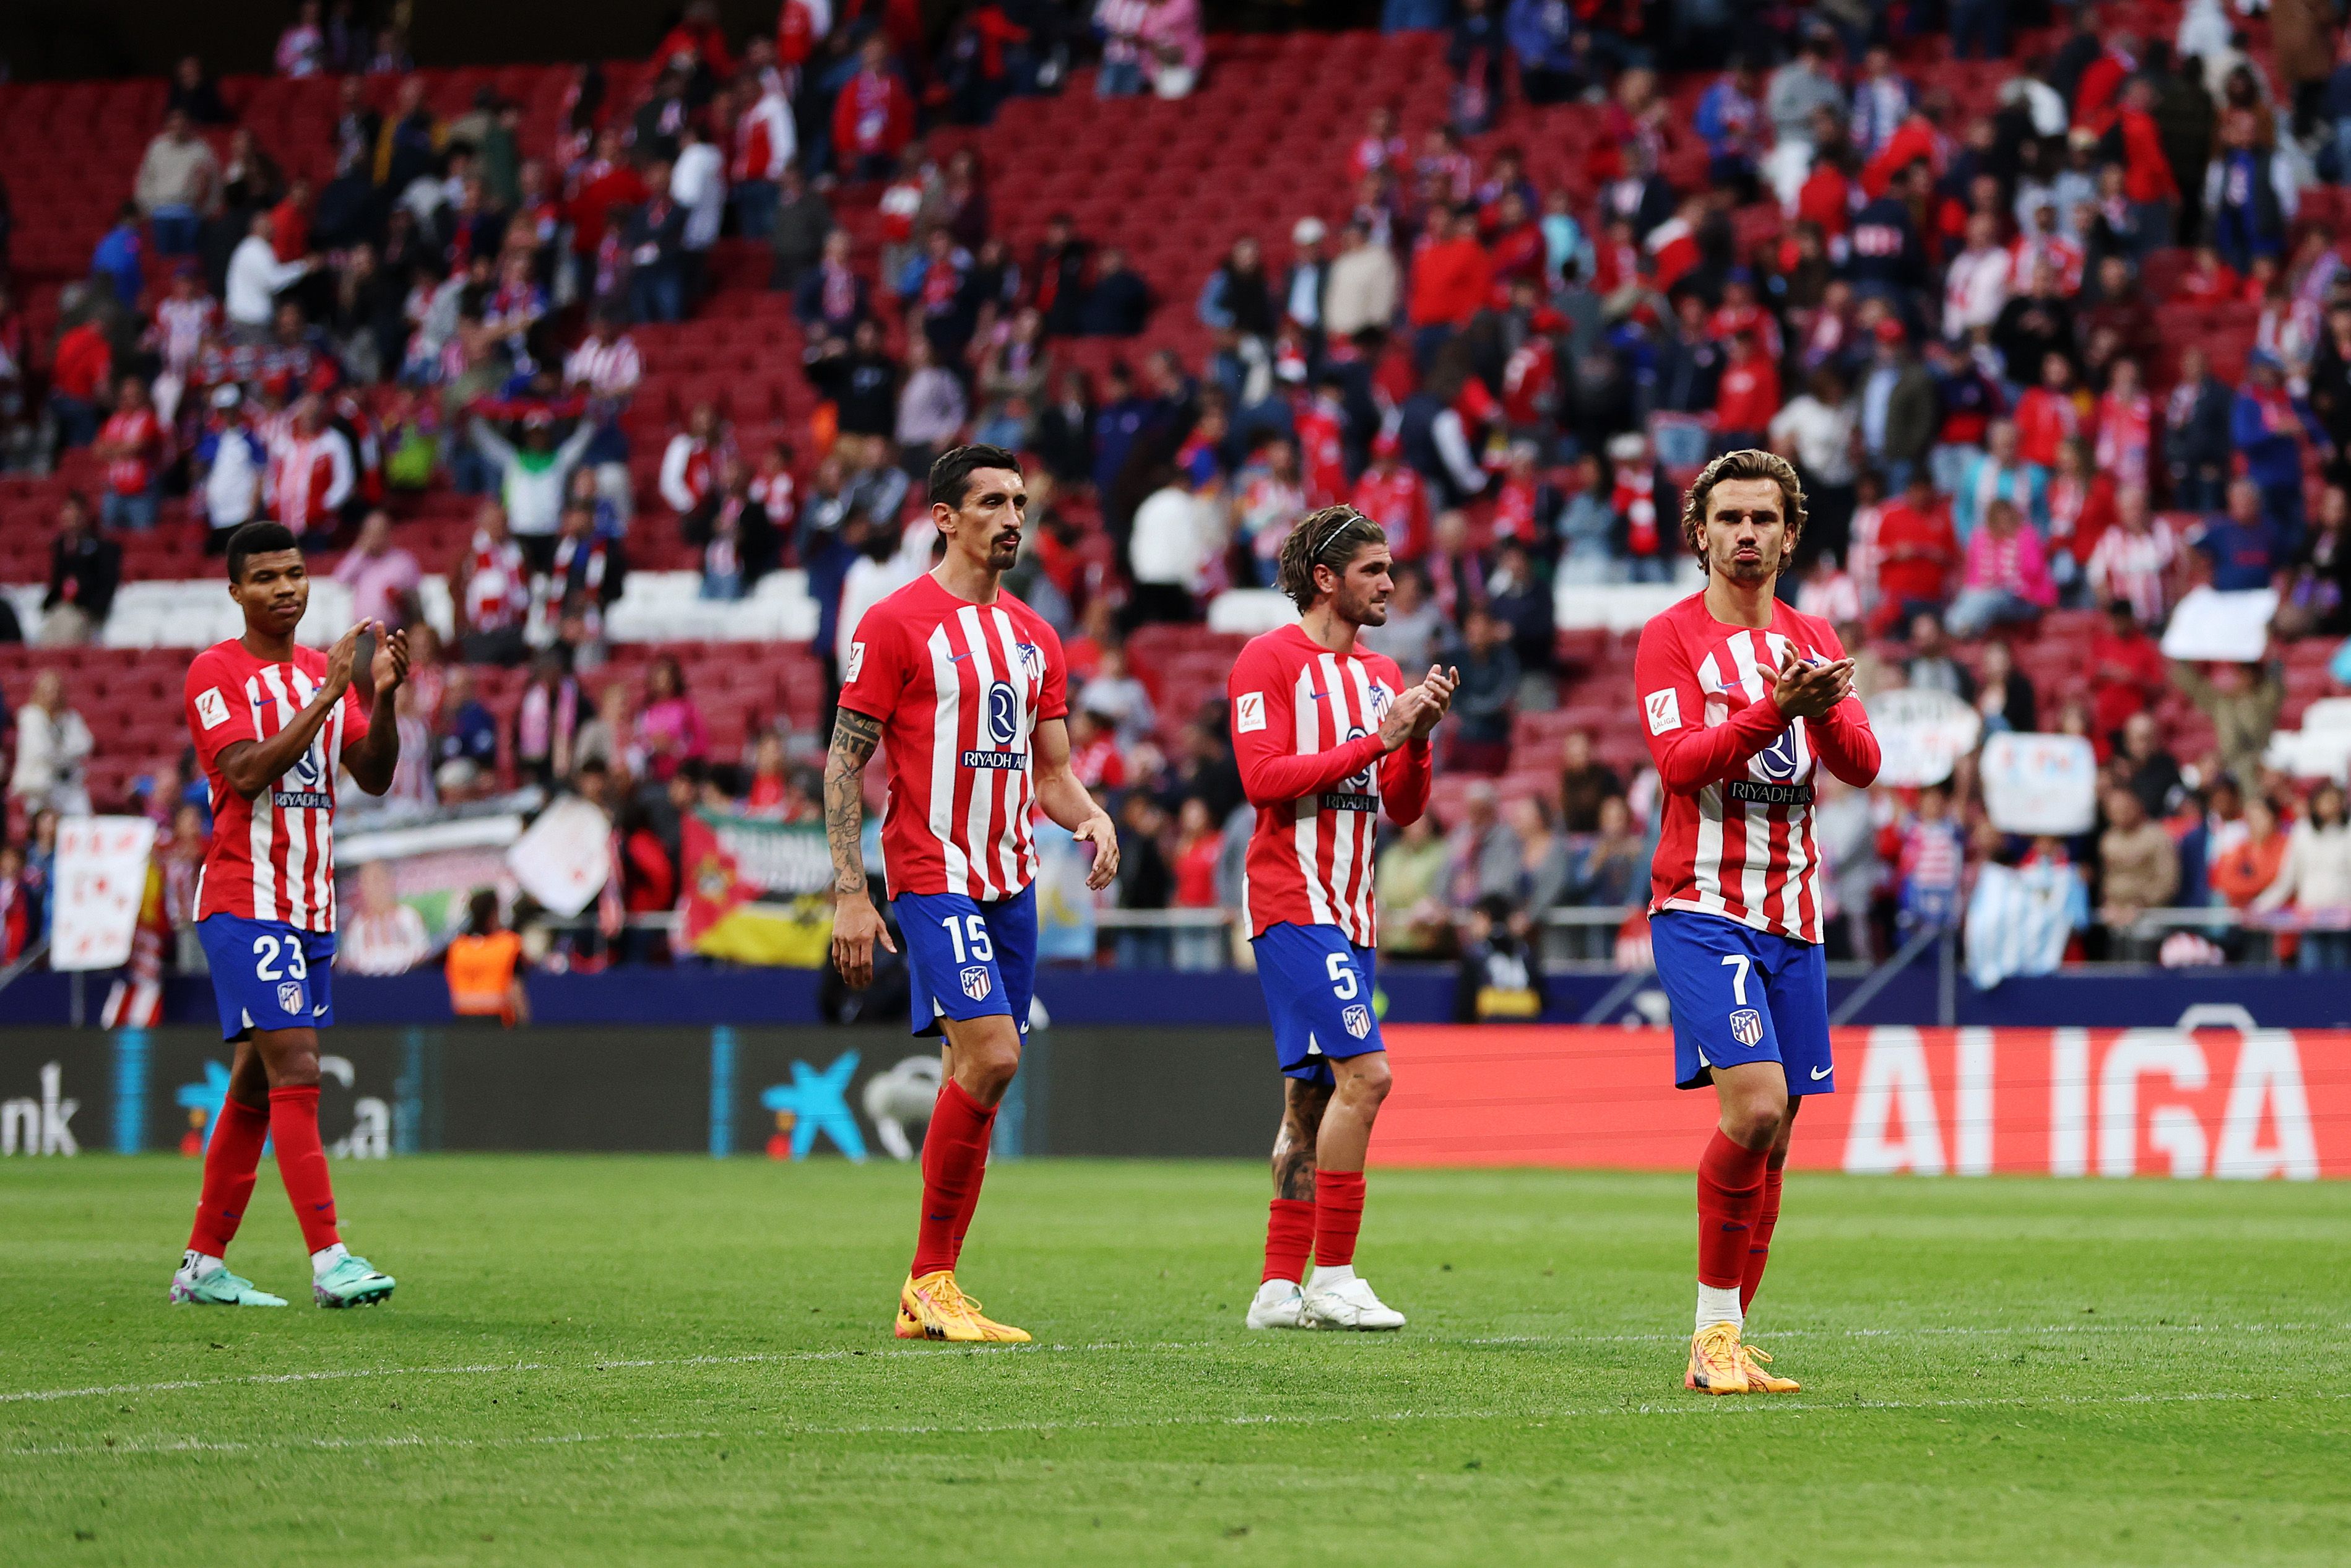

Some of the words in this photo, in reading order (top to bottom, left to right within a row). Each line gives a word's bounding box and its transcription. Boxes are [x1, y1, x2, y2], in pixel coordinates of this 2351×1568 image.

[1653, 717, 1676, 730] LALIGA
[964, 752, 1012, 768] RIYADH
[1326, 795, 1370, 810] RIYADH
[1732, 782, 1795, 803] RIYADH
[1796, 786, 1811, 803] AIR
[942, 915, 994, 964] 15
[253, 935, 307, 982] 23
[1325, 952, 1358, 1000] 5
[1721, 954, 1751, 1005] 7
